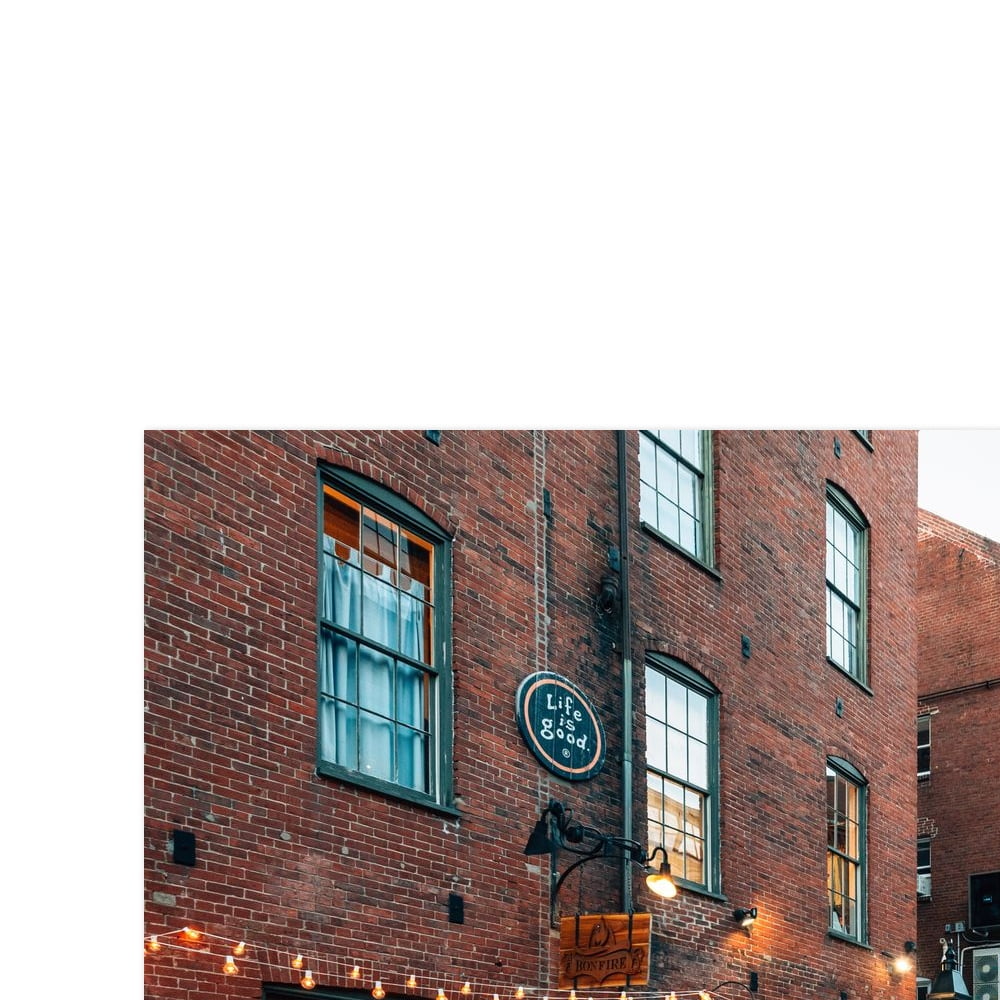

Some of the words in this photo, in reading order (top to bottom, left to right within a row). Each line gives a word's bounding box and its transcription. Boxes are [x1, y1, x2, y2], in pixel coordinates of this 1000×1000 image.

[546, 693, 582, 721] Life
[559, 713, 576, 731] is
[540, 718, 590, 751] good.
[576, 957, 627, 972] BONFIRE
